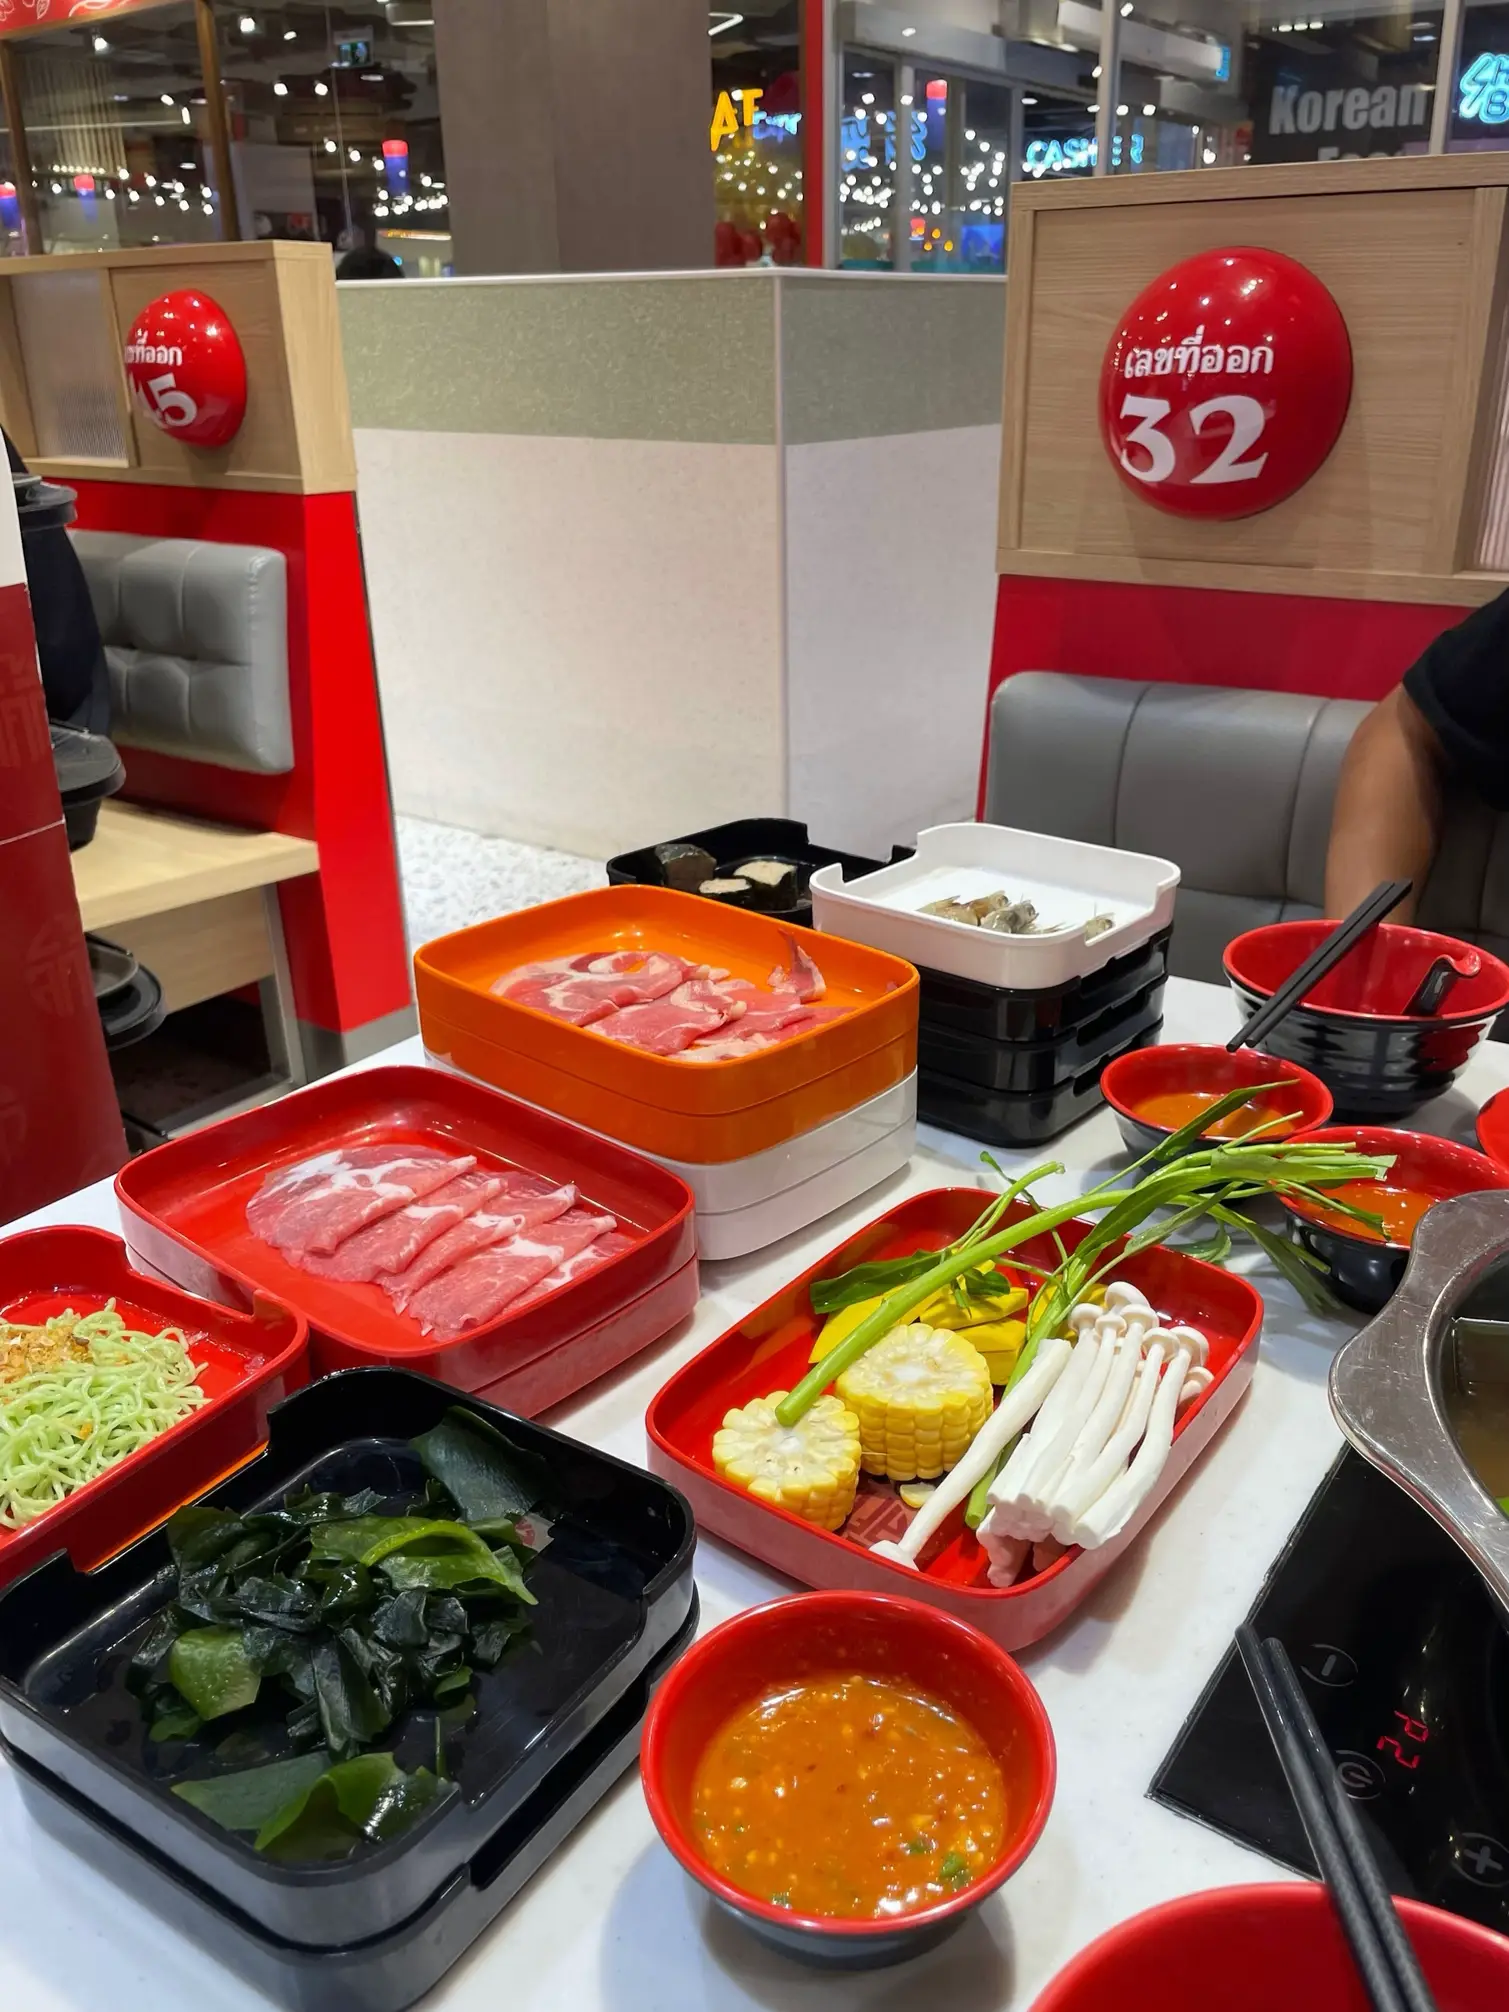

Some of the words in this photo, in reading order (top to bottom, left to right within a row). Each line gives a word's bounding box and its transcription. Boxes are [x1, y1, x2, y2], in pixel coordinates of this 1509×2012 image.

[1269, 84, 1428, 135] Korean
[1123, 325, 1275, 379] เลขที่ออก
[1119, 393, 1269, 484] 32
